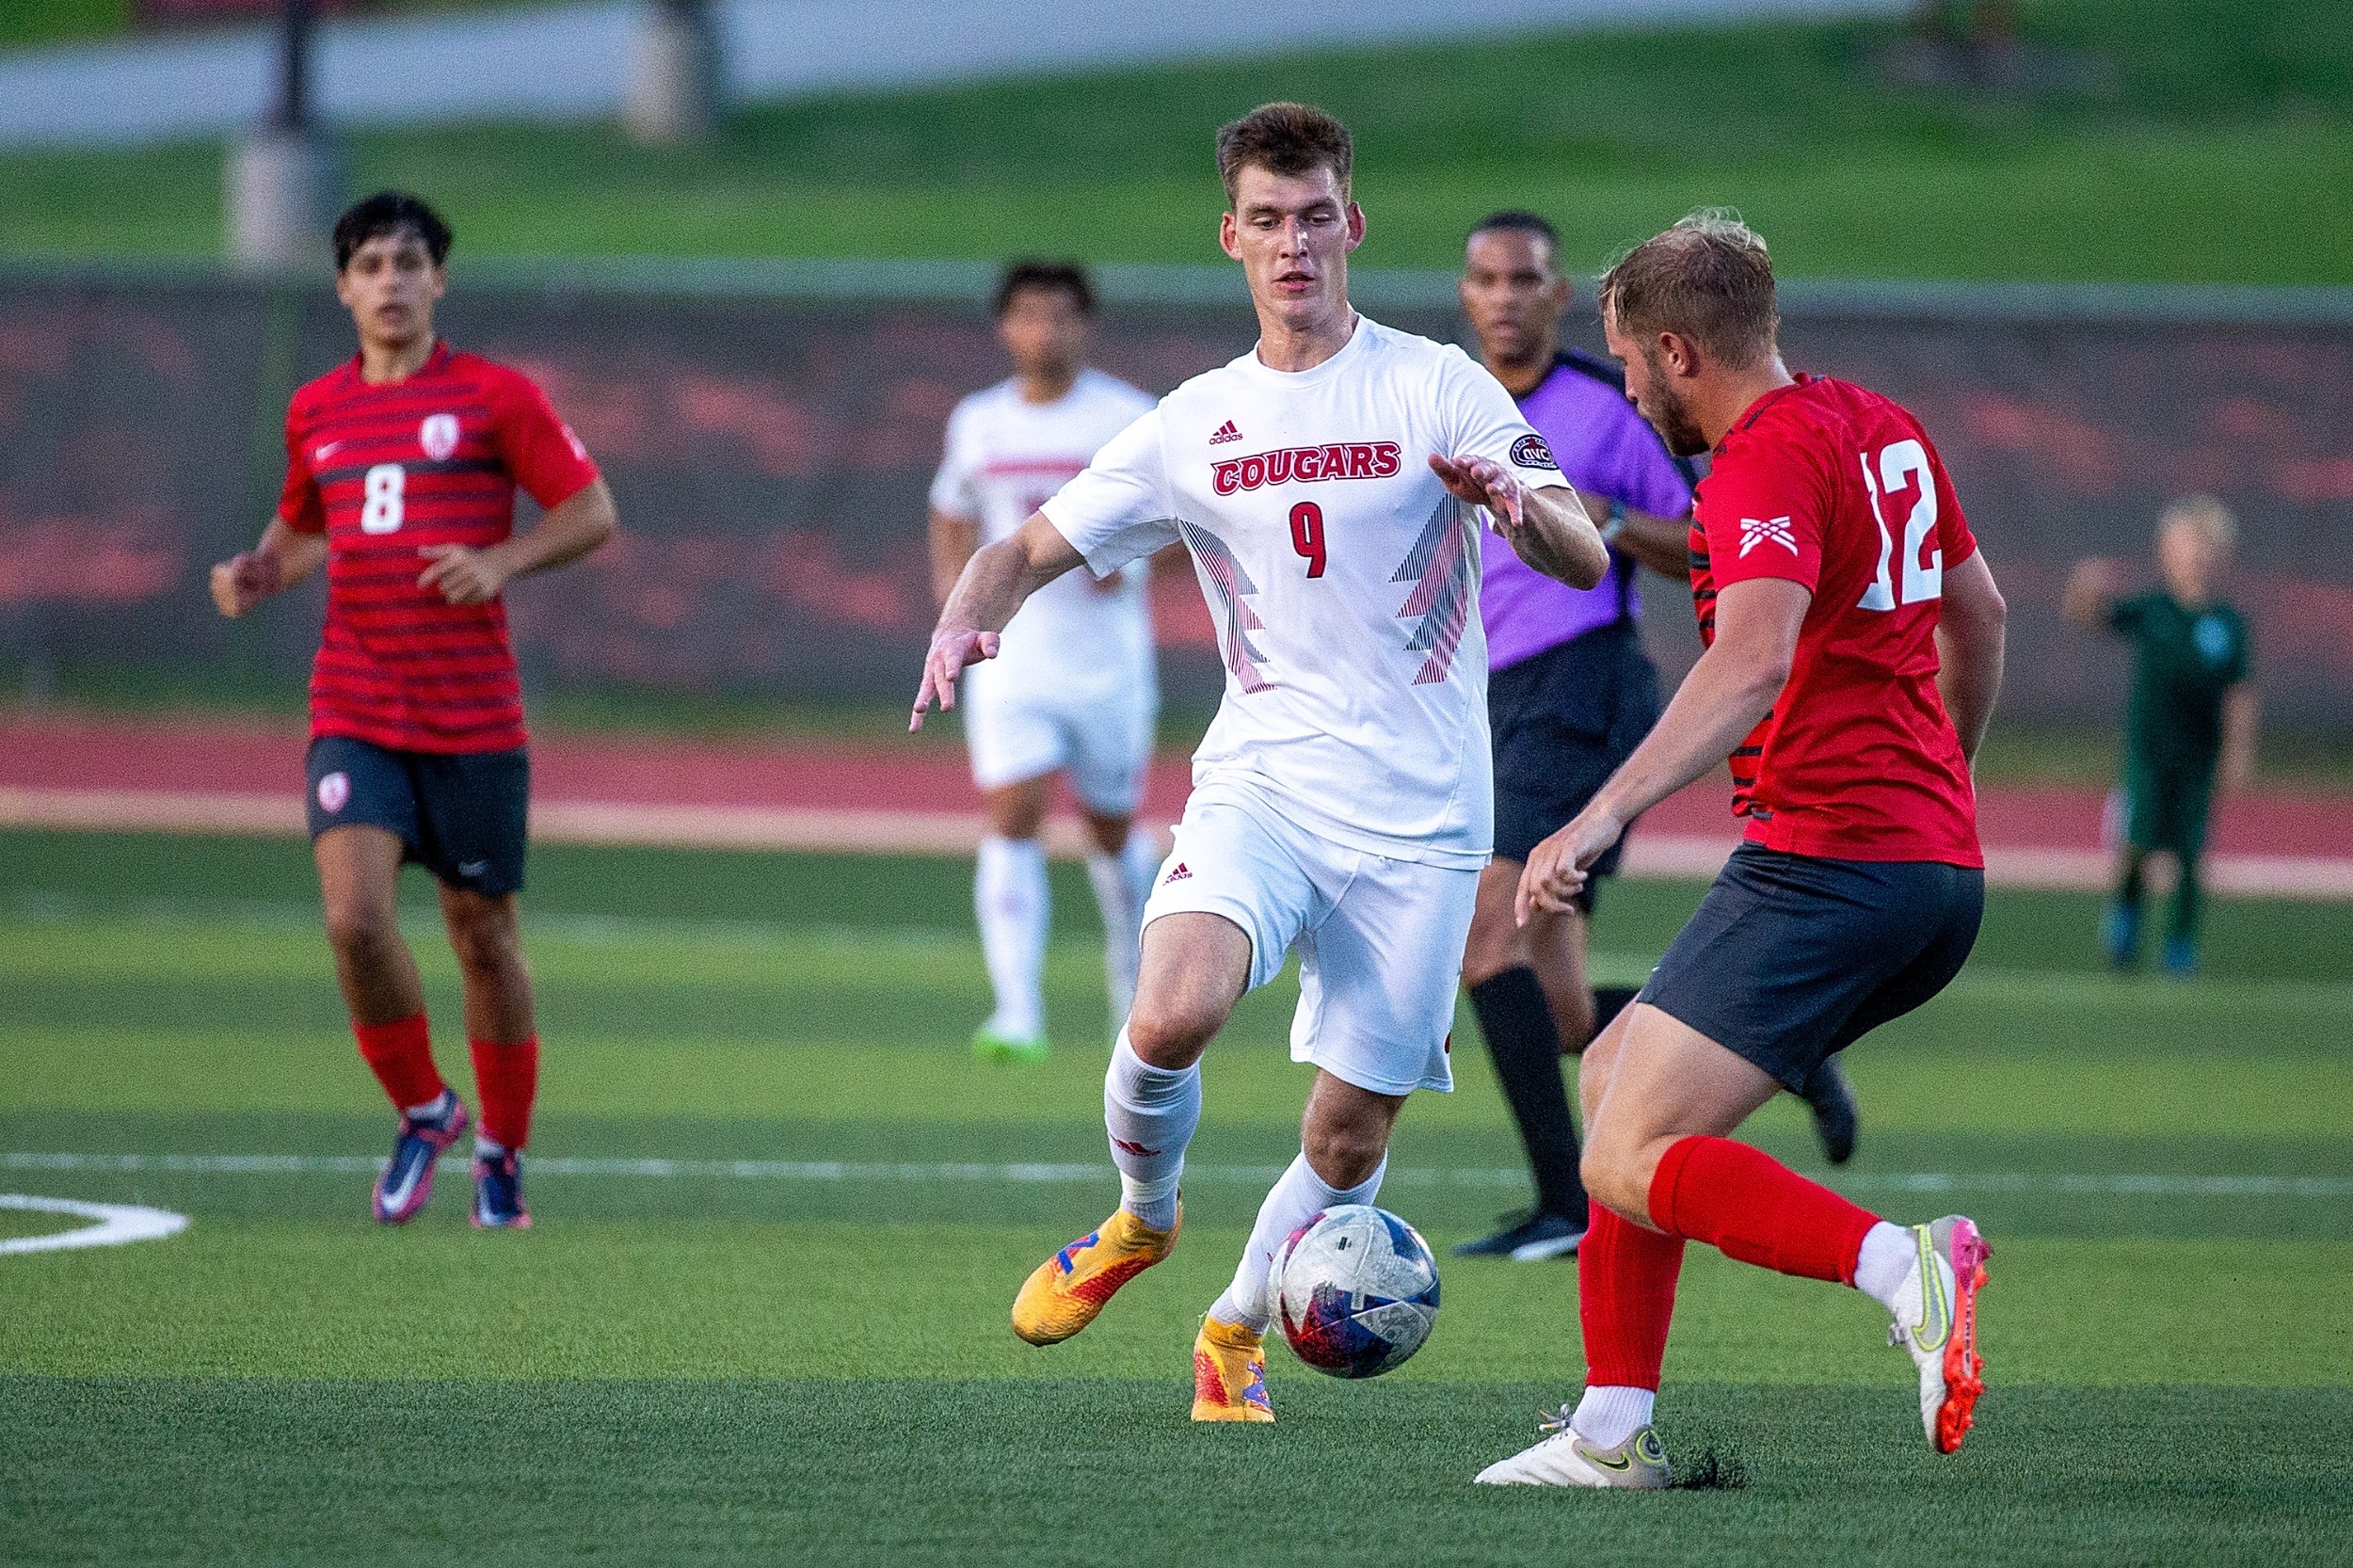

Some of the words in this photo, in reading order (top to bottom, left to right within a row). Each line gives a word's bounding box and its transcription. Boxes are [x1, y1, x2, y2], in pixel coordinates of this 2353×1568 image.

[1209, 433, 1243, 445] adidas
[1210, 440, 1401, 496] COUGARS
[361, 464, 406, 535] 8
[1856, 439, 1943, 611] 12
[1289, 501, 1327, 579] 9
